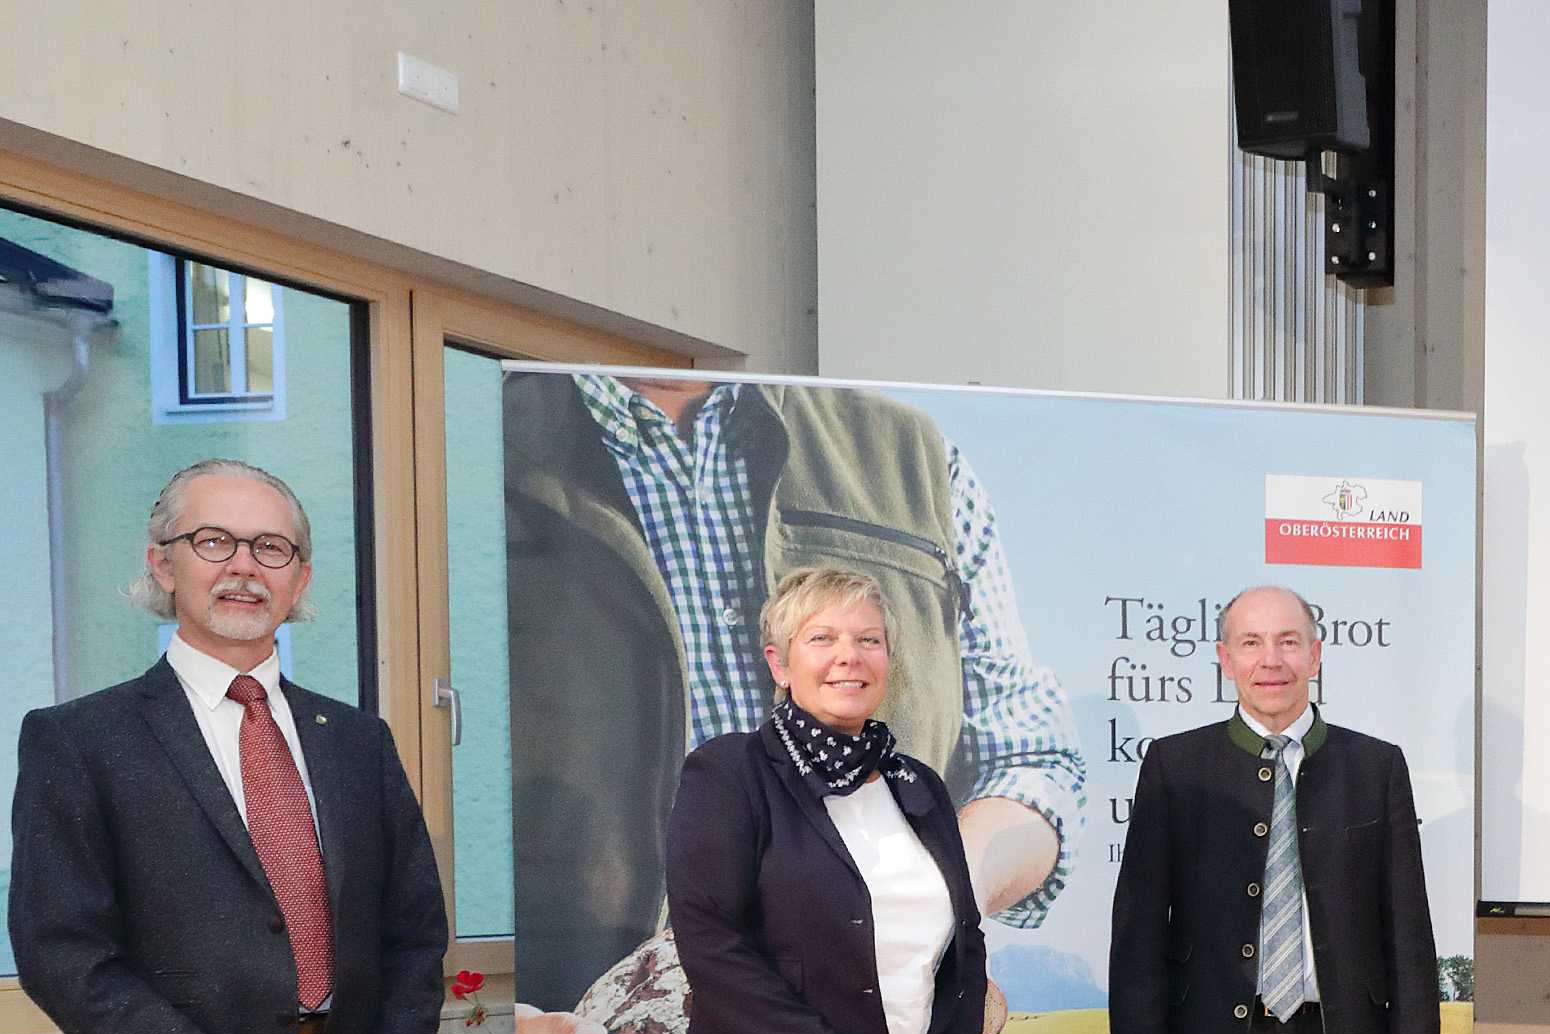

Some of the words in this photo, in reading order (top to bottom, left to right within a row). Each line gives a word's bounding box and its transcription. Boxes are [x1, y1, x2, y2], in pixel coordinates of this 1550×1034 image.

[1279, 522, 1410, 541] OBERÖSTERREICH
[1369, 509, 1410, 523] LAND
[1104, 595, 1222, 658] Tägli
[1107, 656, 1193, 704] fürs
